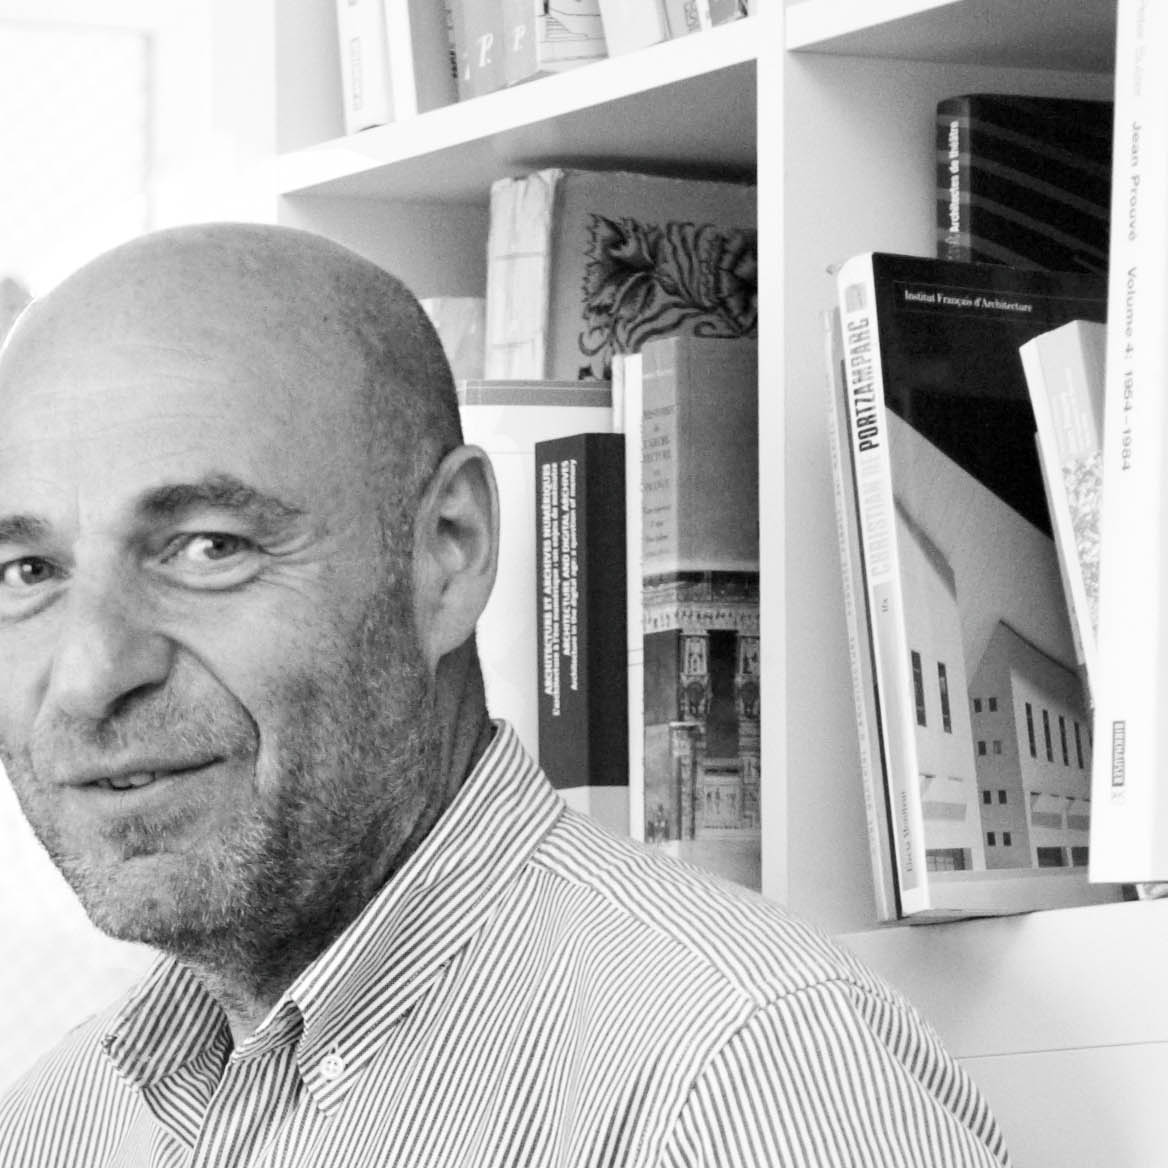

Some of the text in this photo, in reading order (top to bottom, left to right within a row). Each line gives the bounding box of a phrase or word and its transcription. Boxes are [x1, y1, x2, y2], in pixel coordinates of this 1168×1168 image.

[1131, 120, 1143, 168] Jean
[949, 174, 960, 233] Architectes
[1127, 174, 1141, 242] Prouvé
[1124, 266, 1139, 338] Volume
[846, 316, 881, 453] PORTZAMPARC
[542, 538, 552, 594] ARCHIVES
[560, 460, 571, 655] ARCHITECTURE AND DIGITAL ARCHIVES
[543, 612, 553, 694] ARCHITECTURE
